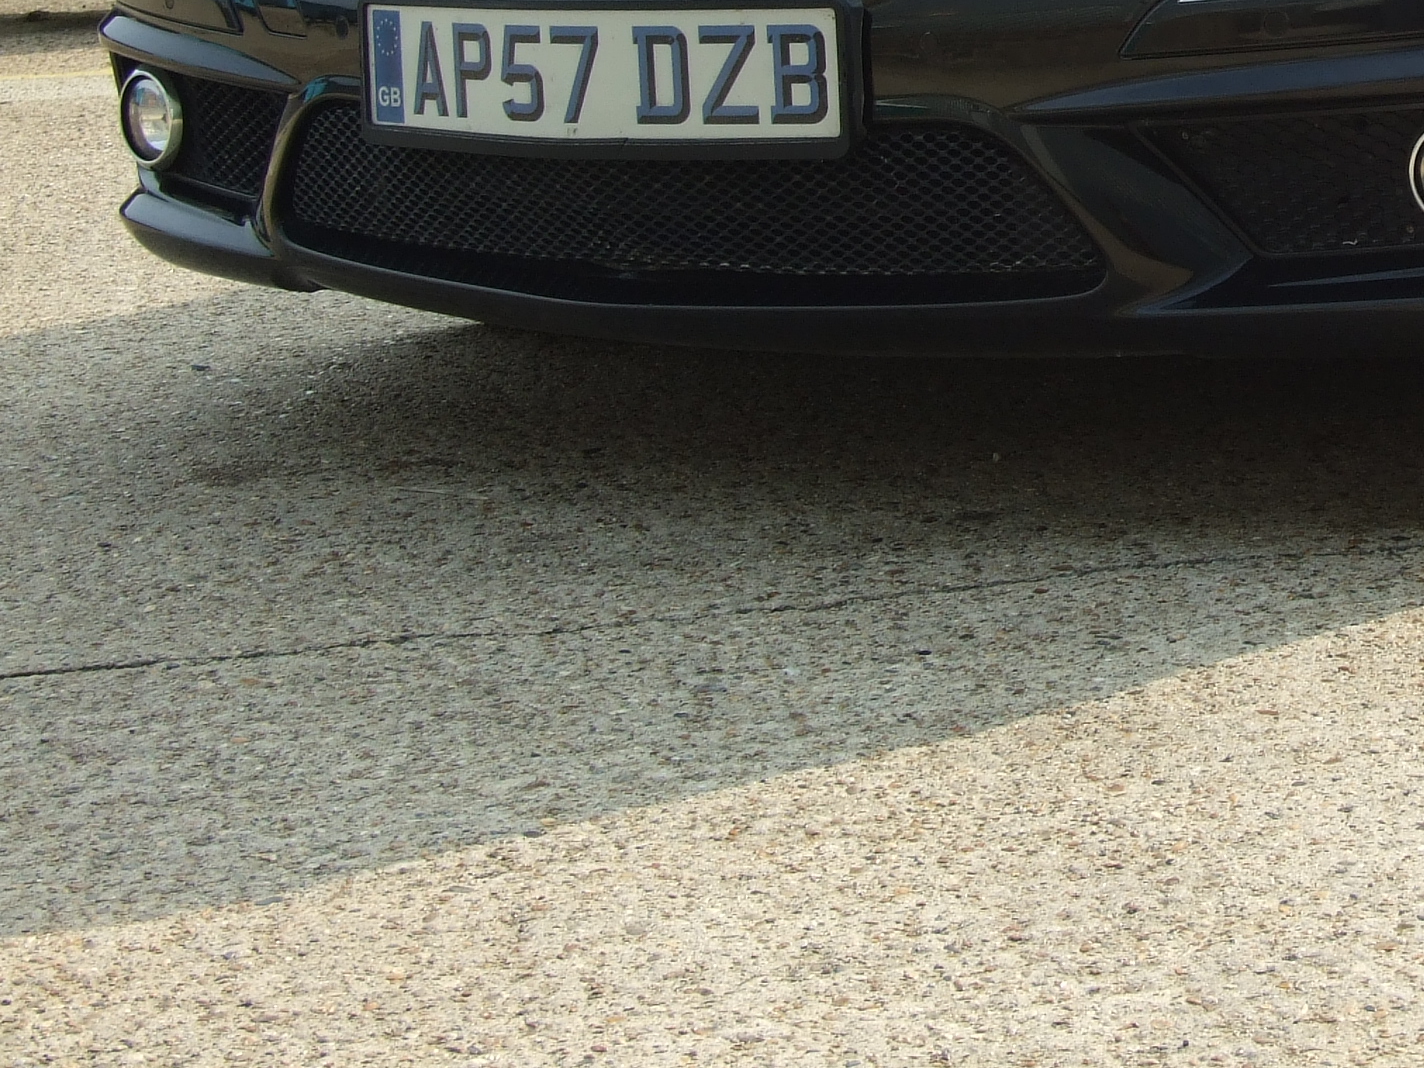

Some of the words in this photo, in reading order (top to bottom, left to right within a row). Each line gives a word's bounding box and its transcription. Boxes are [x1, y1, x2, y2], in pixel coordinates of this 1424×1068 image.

[378, 86, 401, 107] GB
[413, 21, 599, 124] AP57
[632, 24, 829, 125] DZB
